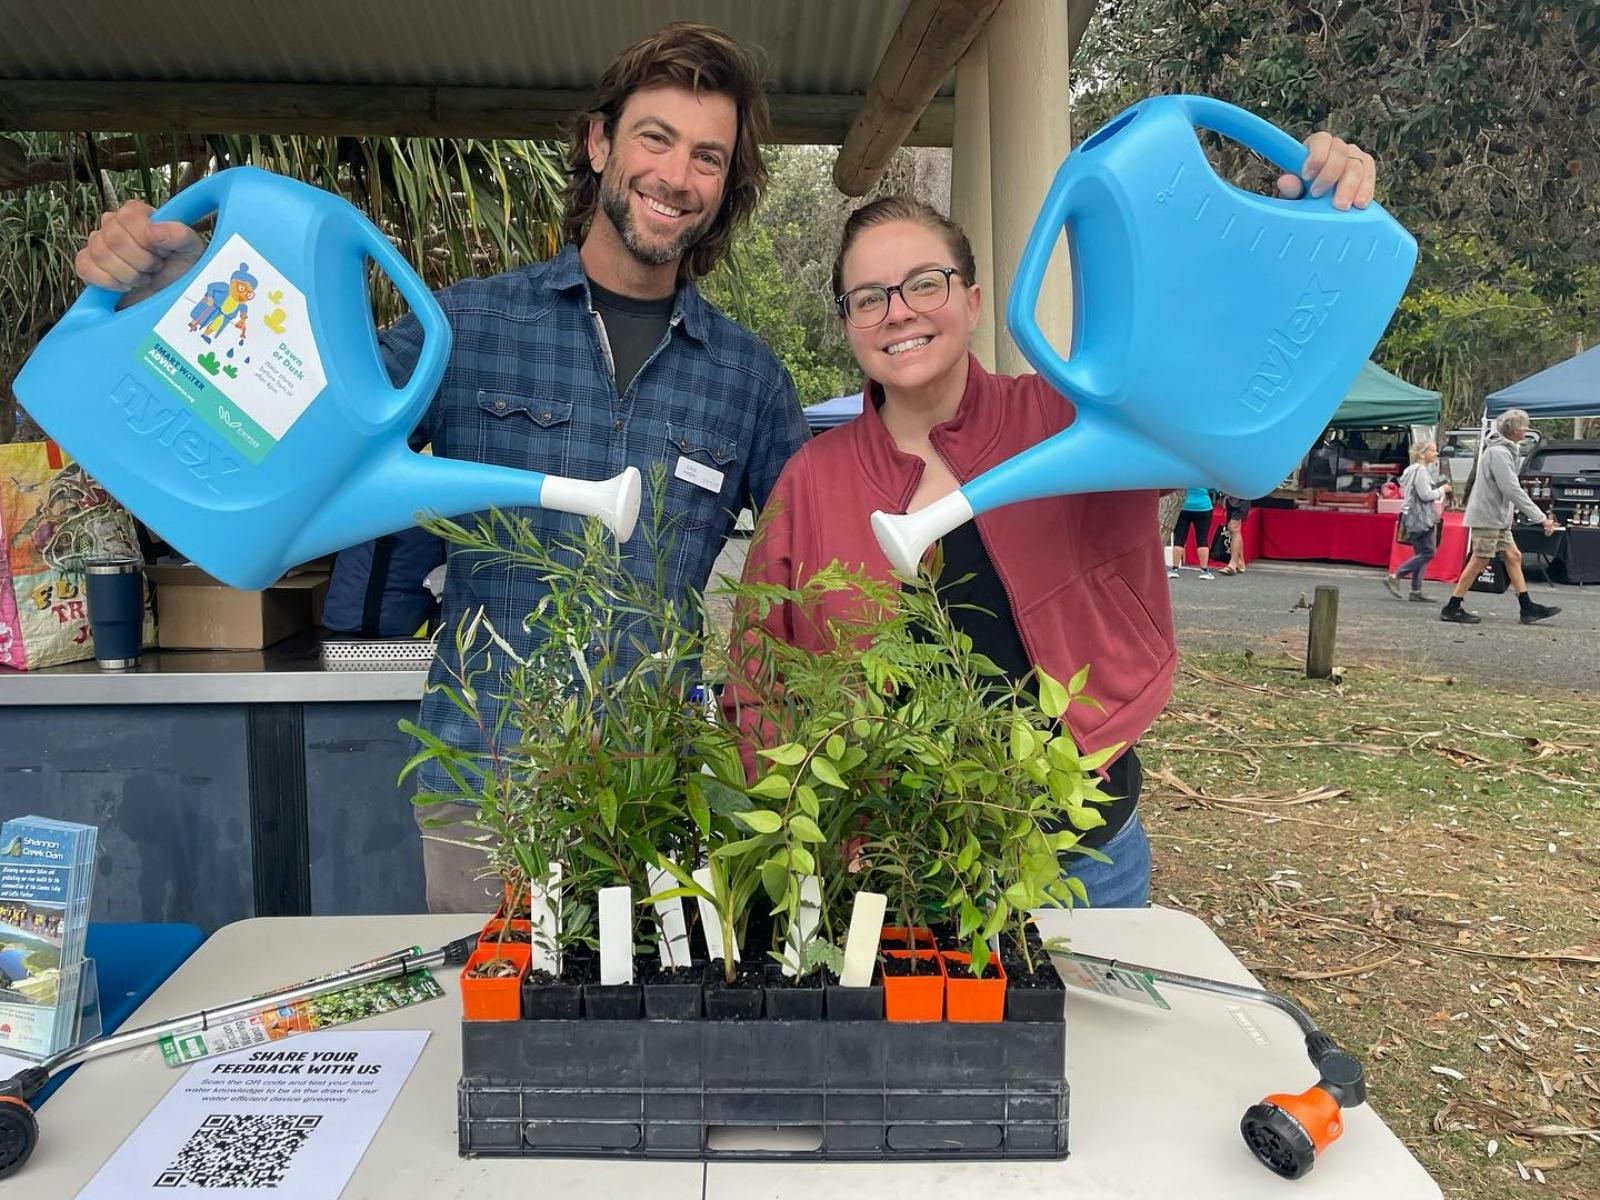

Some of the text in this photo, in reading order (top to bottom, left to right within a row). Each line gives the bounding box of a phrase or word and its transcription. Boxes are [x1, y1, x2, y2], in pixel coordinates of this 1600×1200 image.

[1239, 272, 1341, 413] nylex
[148, 349, 178, 376] ADVICE
[279, 342, 303, 366] Dawn
[153, 343, 206, 391] SMART WATER
[272, 351, 304, 380] or Dusk
[109, 372, 241, 495] nylex
[23, 837, 60, 849] Shannon
[22, 847, 64, 860] Creek Dam
[249, 1051, 359, 1062] SHARE YOUR
[211, 1063, 382, 1075] FEEDBACK WITH US
[213, 1087, 264, 1095] knowledge
[302, 1096, 350, 1104] giveaway
